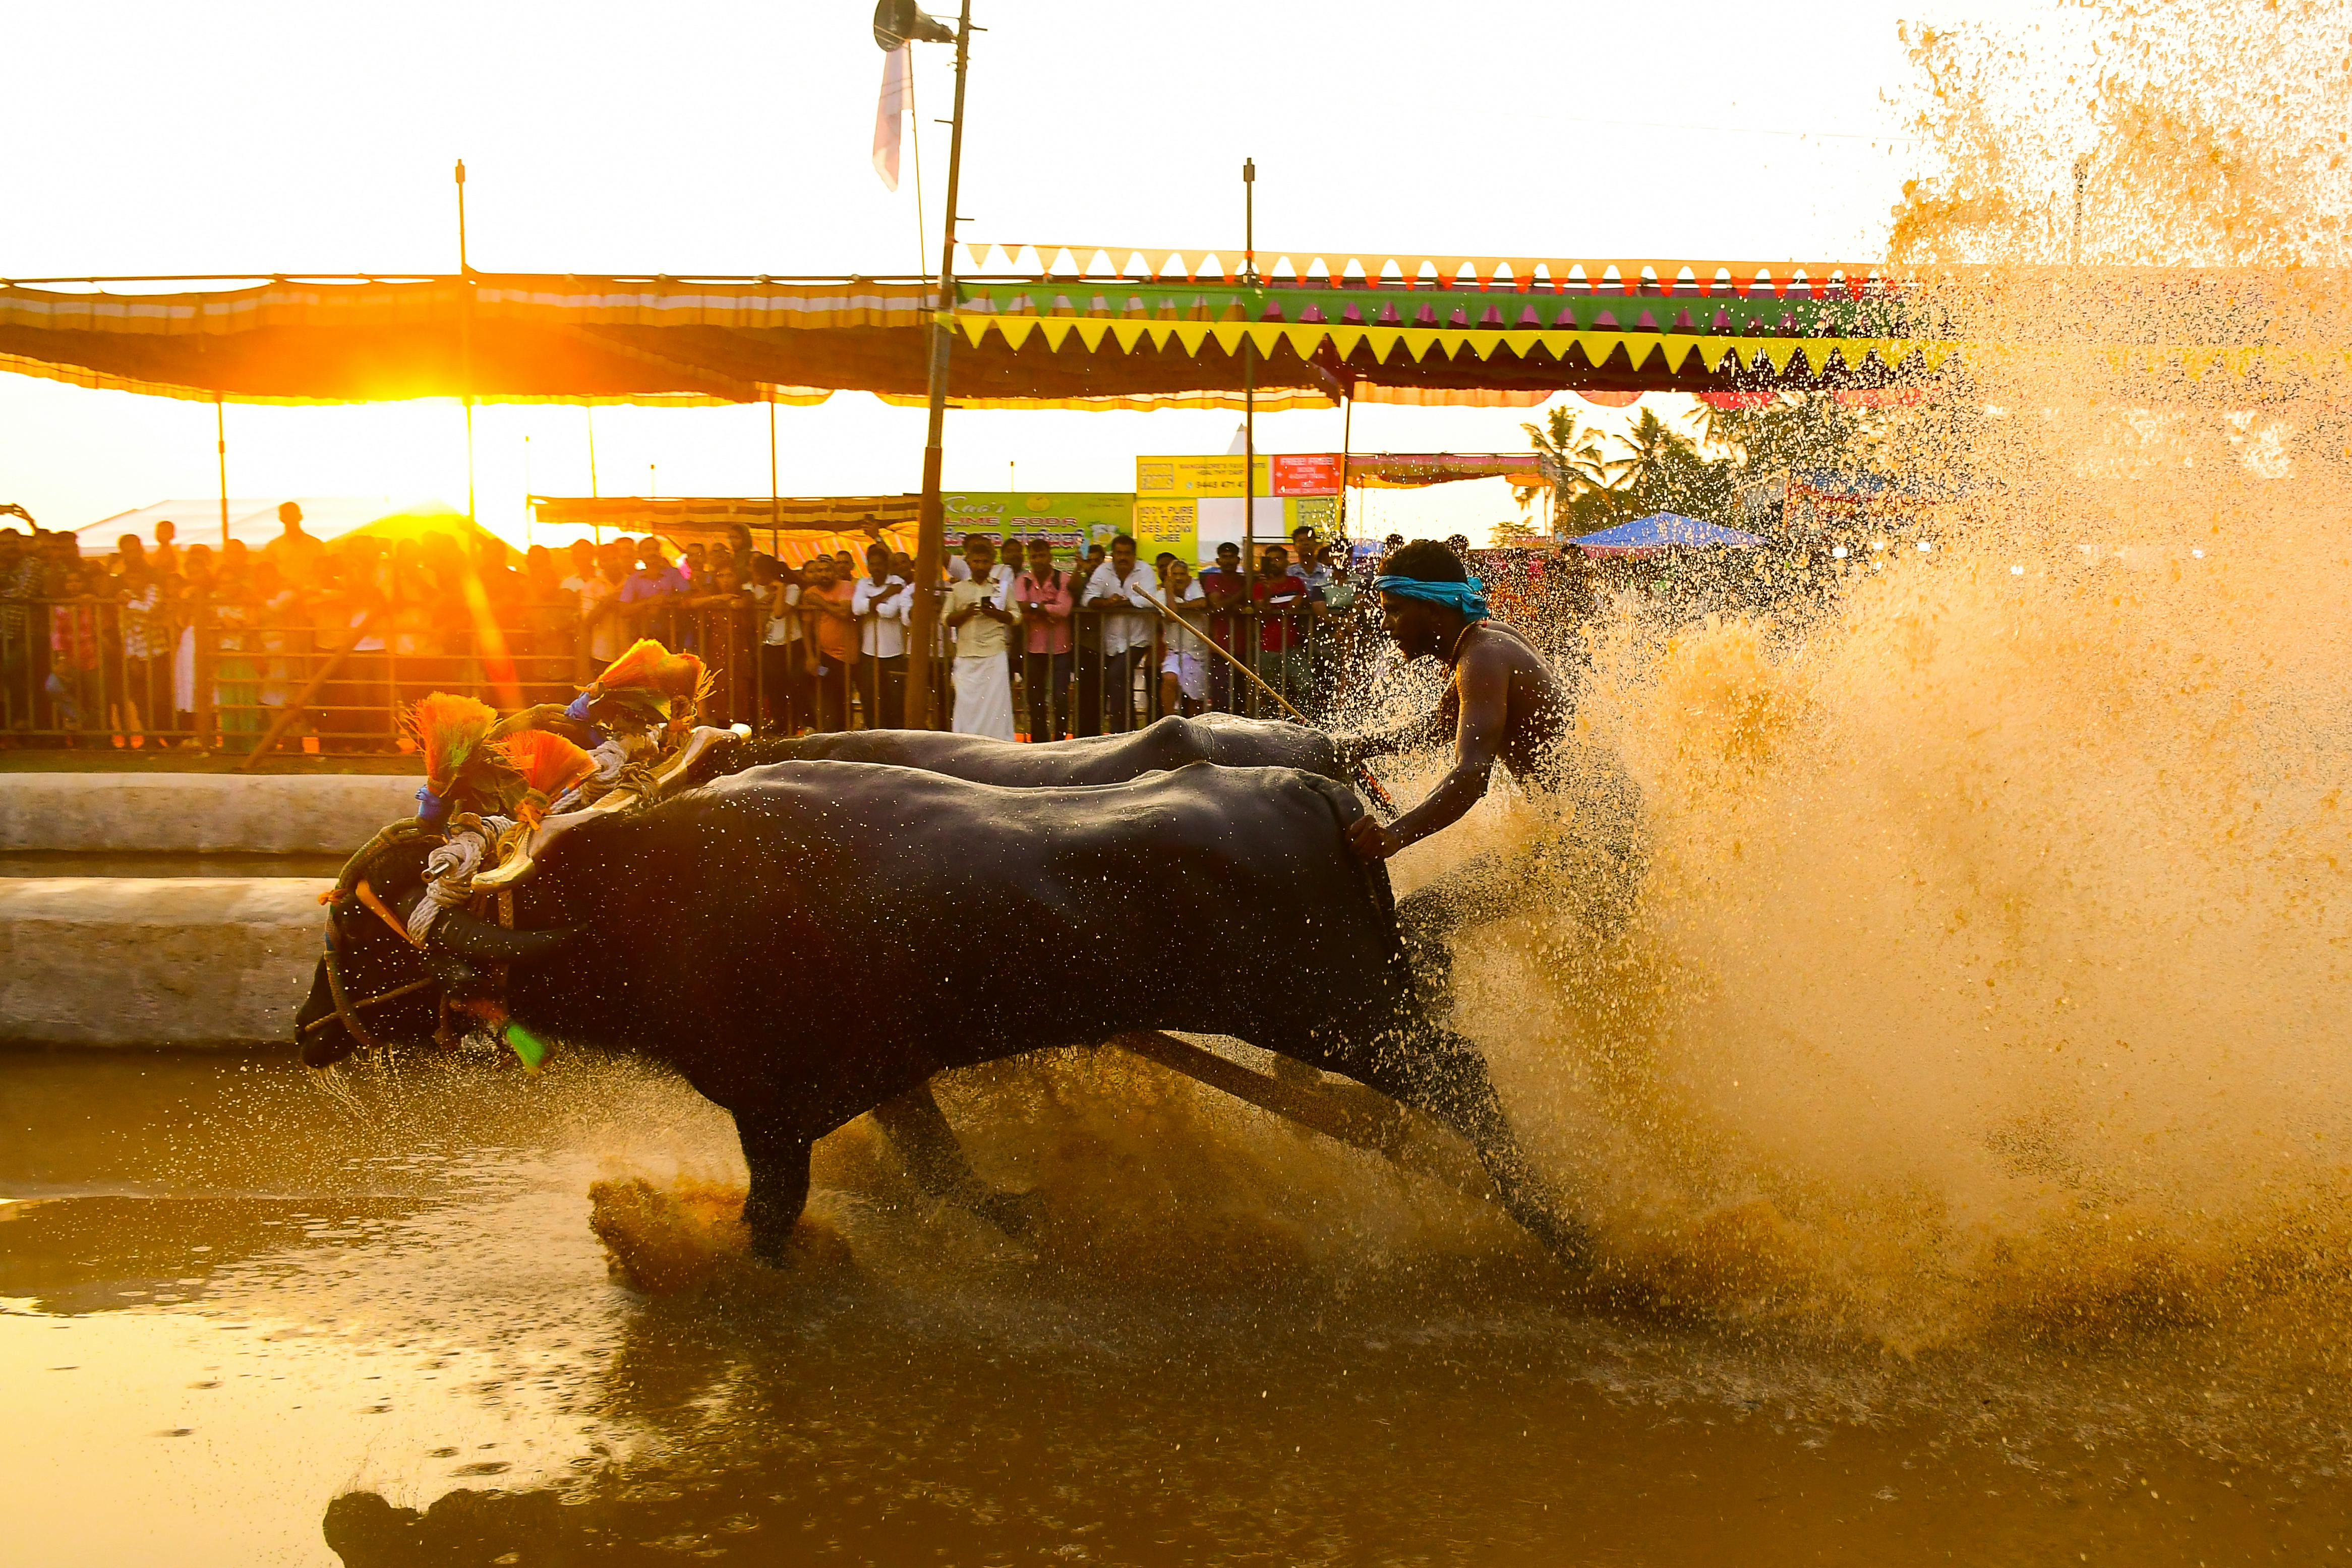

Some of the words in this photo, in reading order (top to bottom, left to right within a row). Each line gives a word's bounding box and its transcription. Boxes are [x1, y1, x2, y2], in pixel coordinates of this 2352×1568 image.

[944, 516, 1000, 526] LIME
[1010, 516, 1078, 526] SODA
[1153, 534, 1181, 542] GHEE
